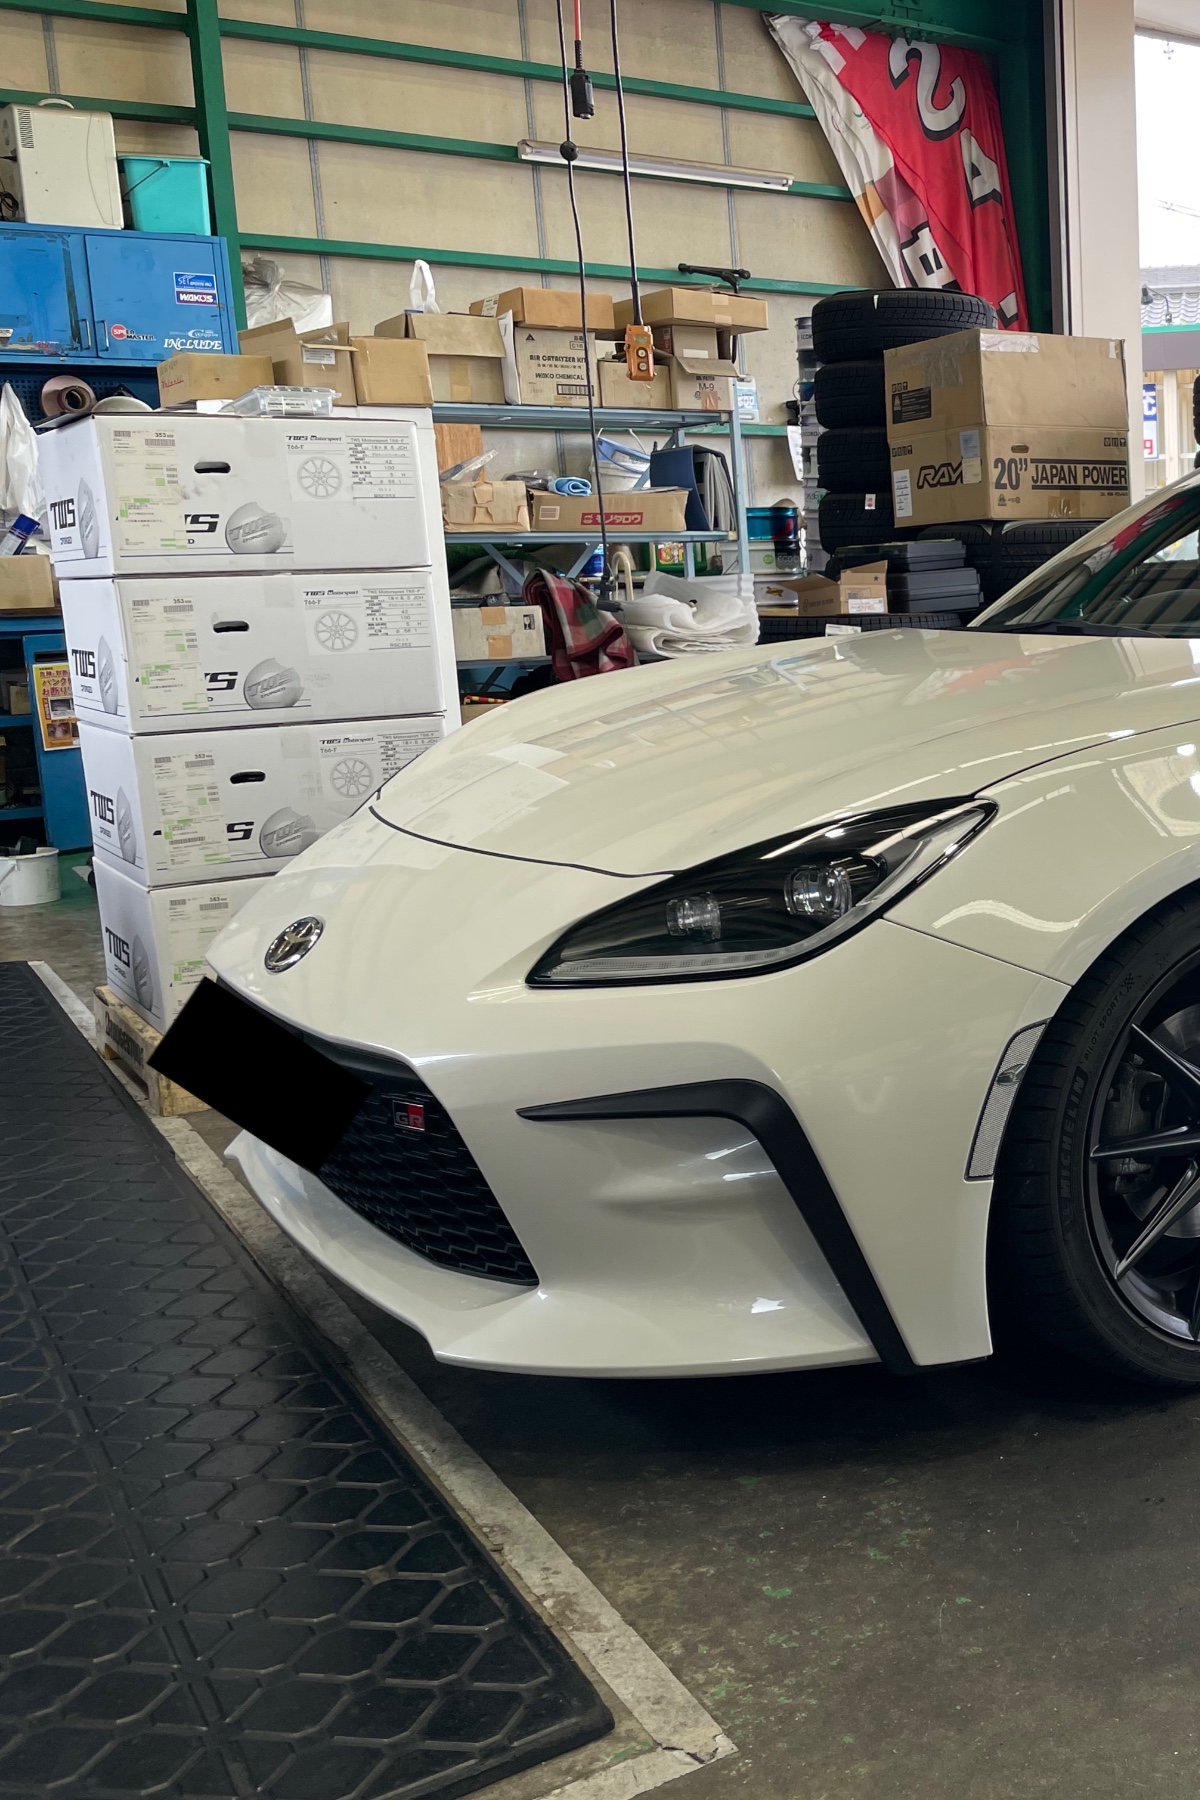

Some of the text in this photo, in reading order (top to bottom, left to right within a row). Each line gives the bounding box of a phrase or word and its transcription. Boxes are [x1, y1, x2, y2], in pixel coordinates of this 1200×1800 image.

[163, 337, 222, 350] INCLUDE
[698, 383, 715, 391] M-9
[917, 460, 963, 489] RAY
[1031, 464, 1077, 485] JAPAN
[1082, 465, 1128, 485] POWER
[50, 498, 76, 530] TWS
[71, 648, 97, 679] TWS
[90, 790, 115, 825] TWS
[105, 926, 131, 968] TWS
[1084, 1032, 1100, 1062] PILOT
[1099, 997, 1119, 1030] SPORT
[395, 1110, 424, 1128] GR
[1059, 1066, 1088, 1199] MICHELIN
